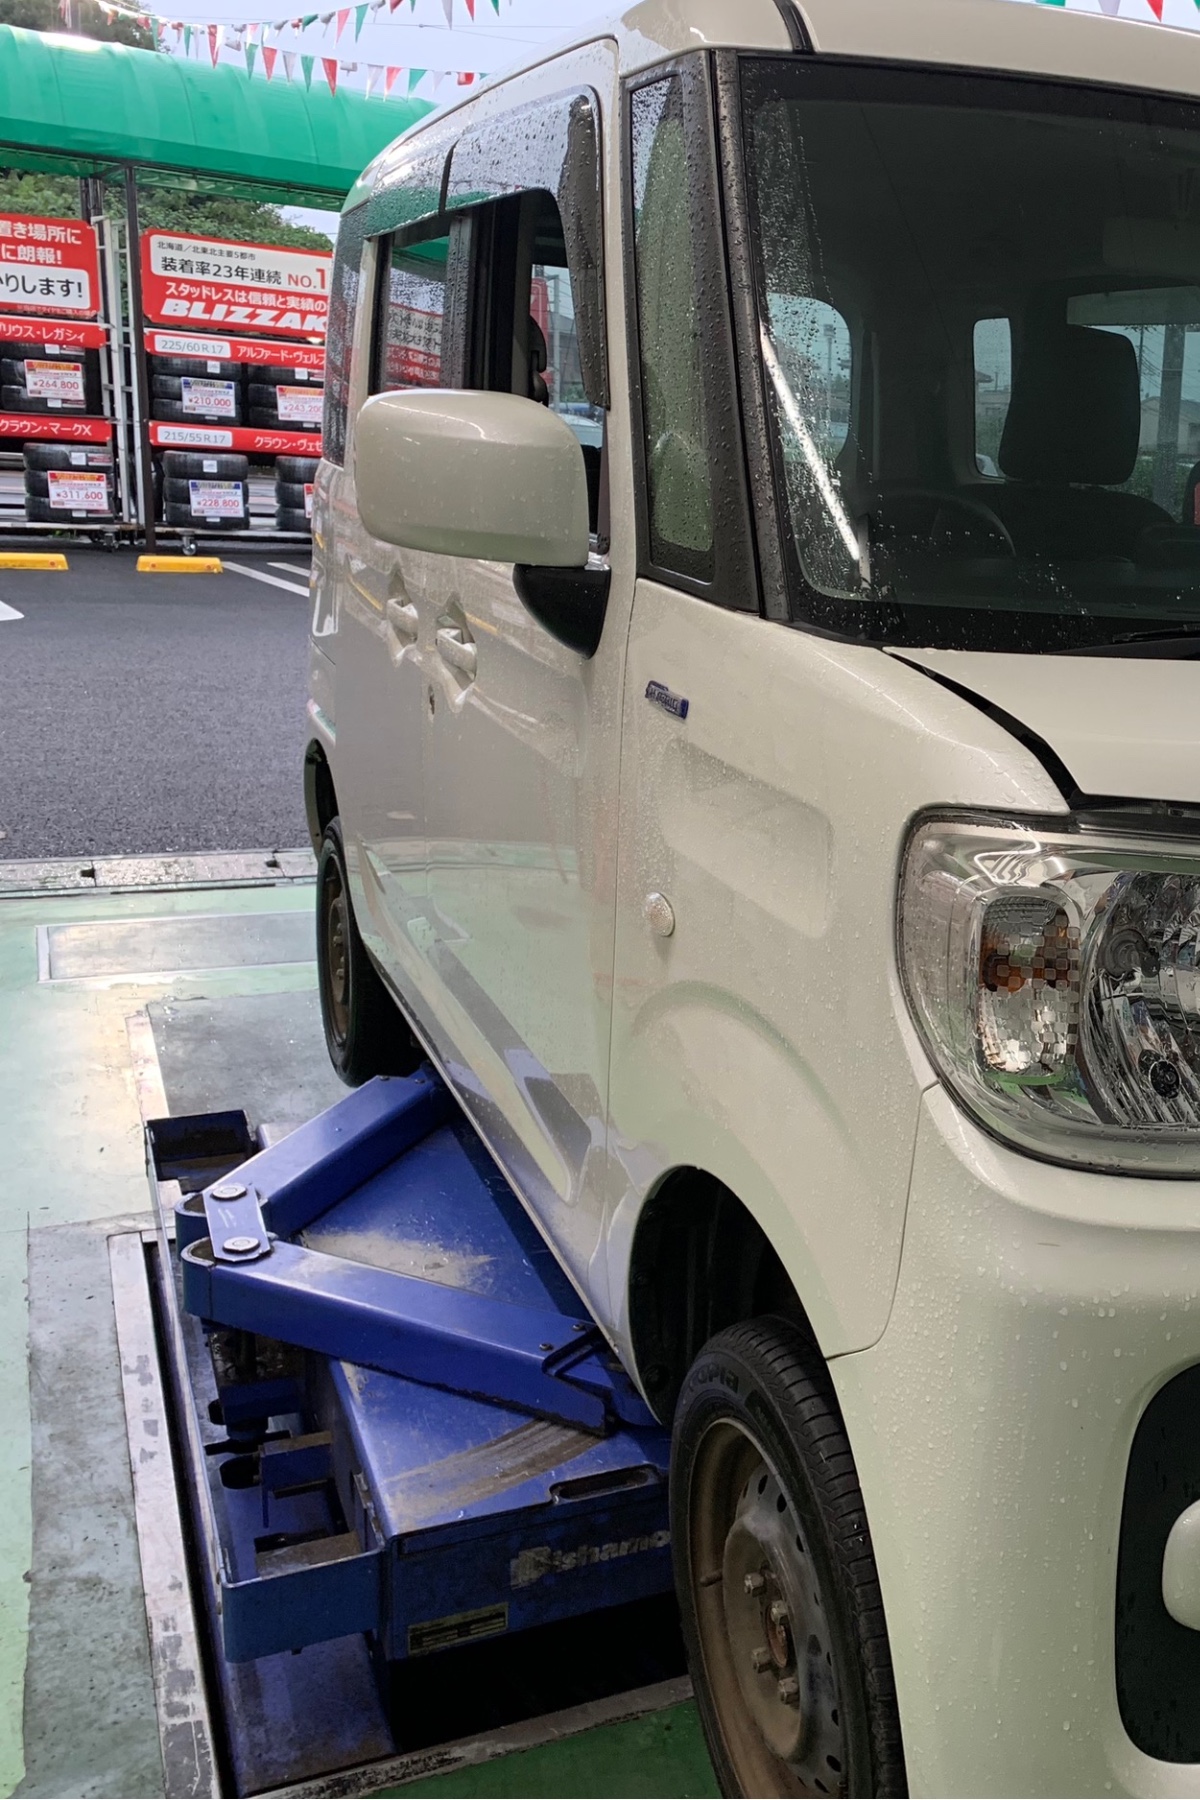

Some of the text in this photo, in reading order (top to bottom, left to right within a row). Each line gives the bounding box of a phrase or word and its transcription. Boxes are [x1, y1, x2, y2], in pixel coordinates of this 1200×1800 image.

[0, 272, 83, 298] りします!
[160, 256, 326, 291] 装着率23年連続 NO.1
[160, 297, 327, 332] BLIZZAK
